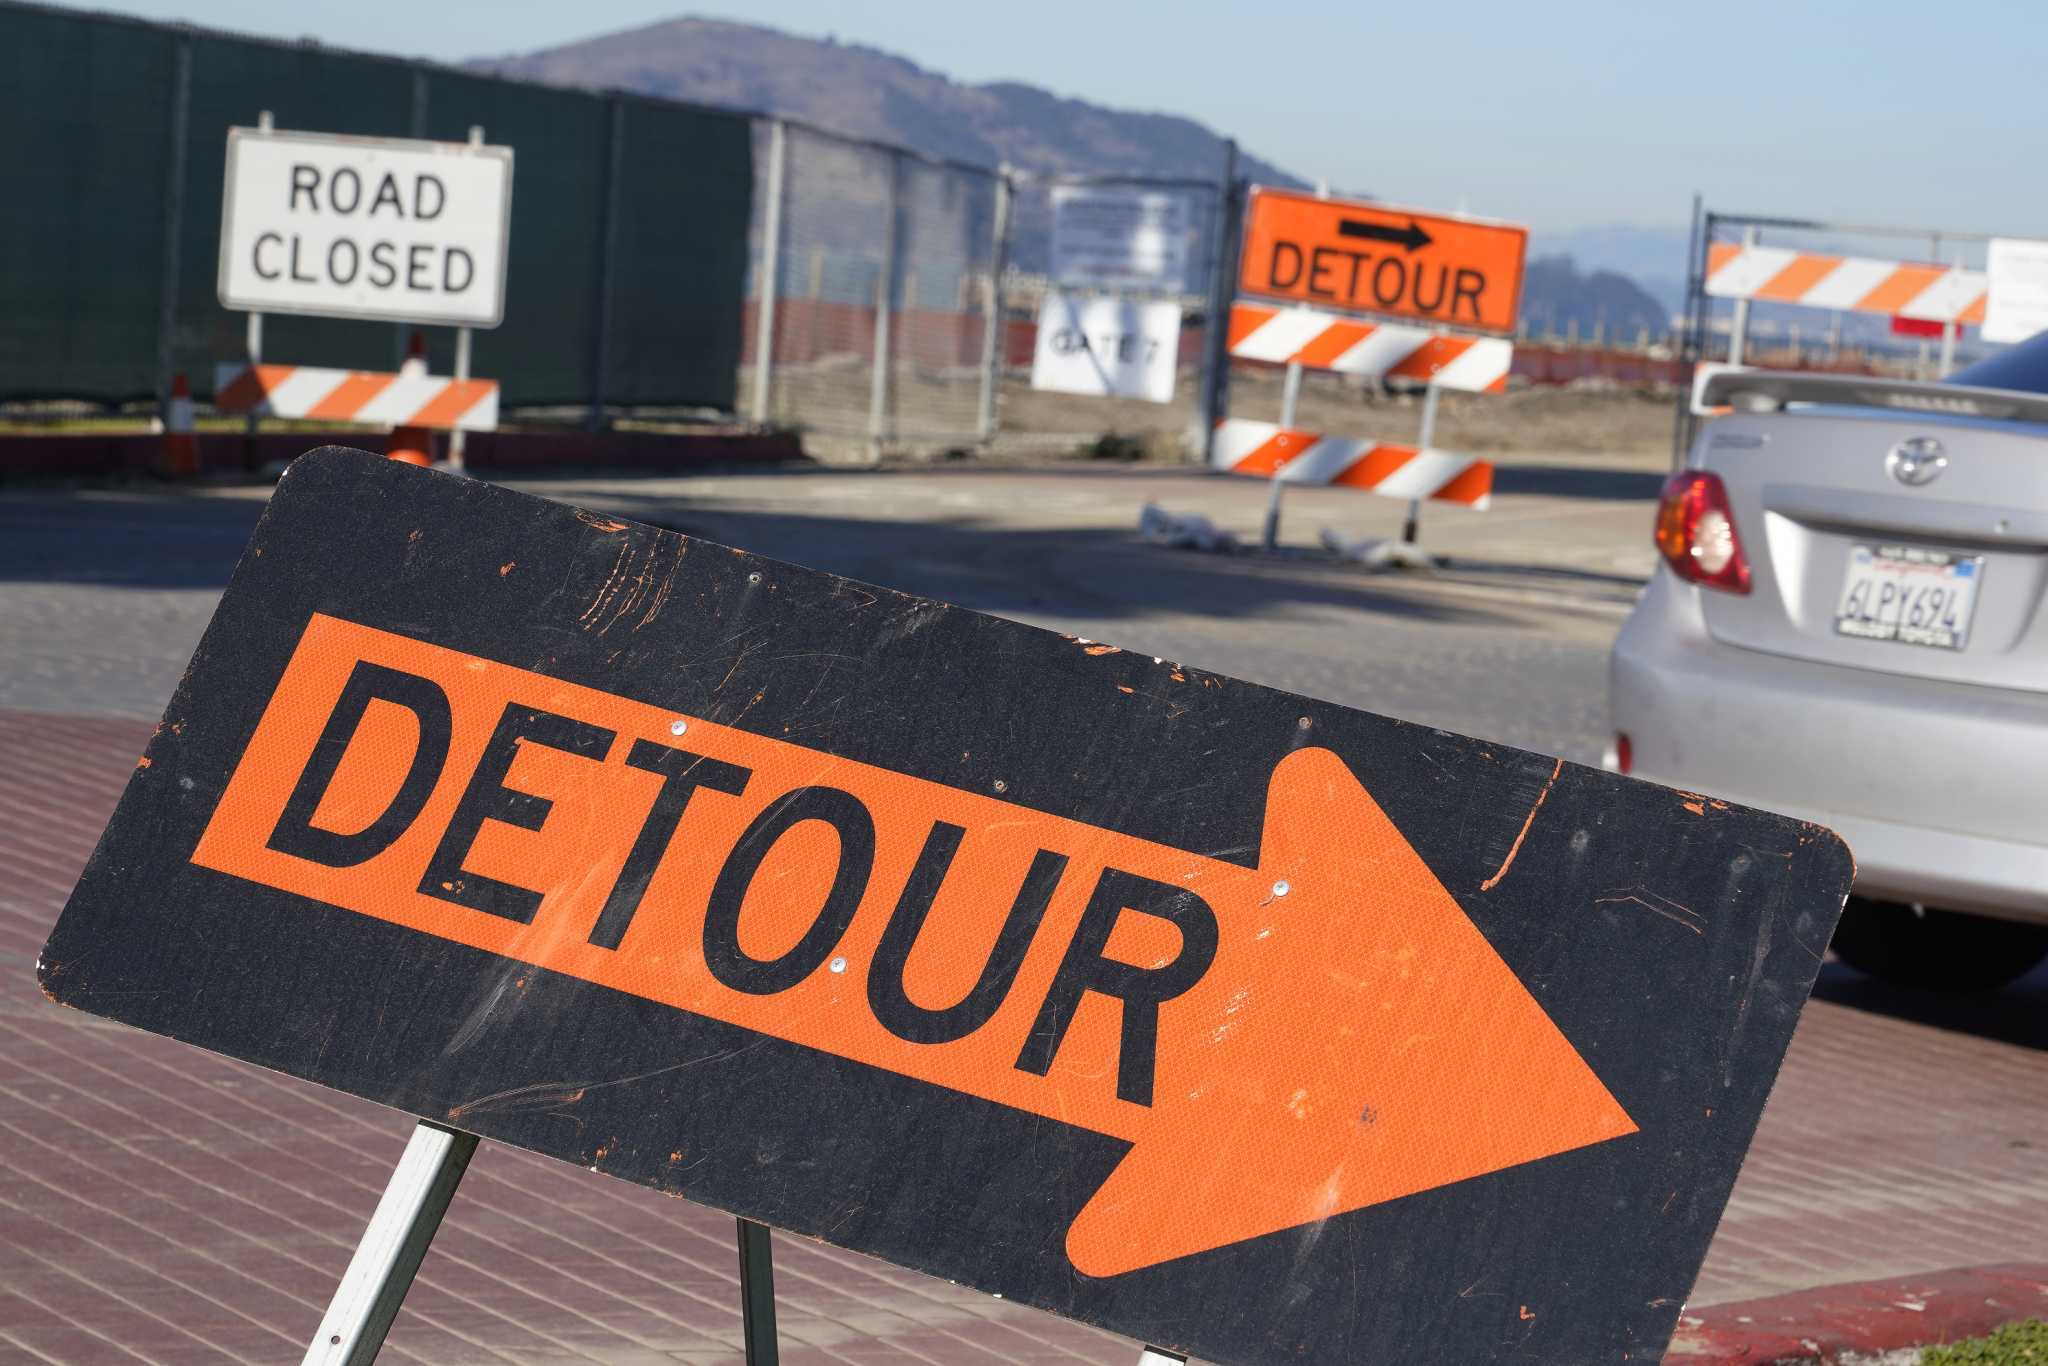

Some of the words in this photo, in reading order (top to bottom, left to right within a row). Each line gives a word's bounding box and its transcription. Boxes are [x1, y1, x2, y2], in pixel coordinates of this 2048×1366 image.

[289, 164, 446, 221] ROAD
[252, 232, 474, 294] CLOSED
[1269, 240, 1486, 322] DETOUR
[1845, 578, 1957, 630] 6LPY694
[266, 659, 1219, 1108] DETOUR
